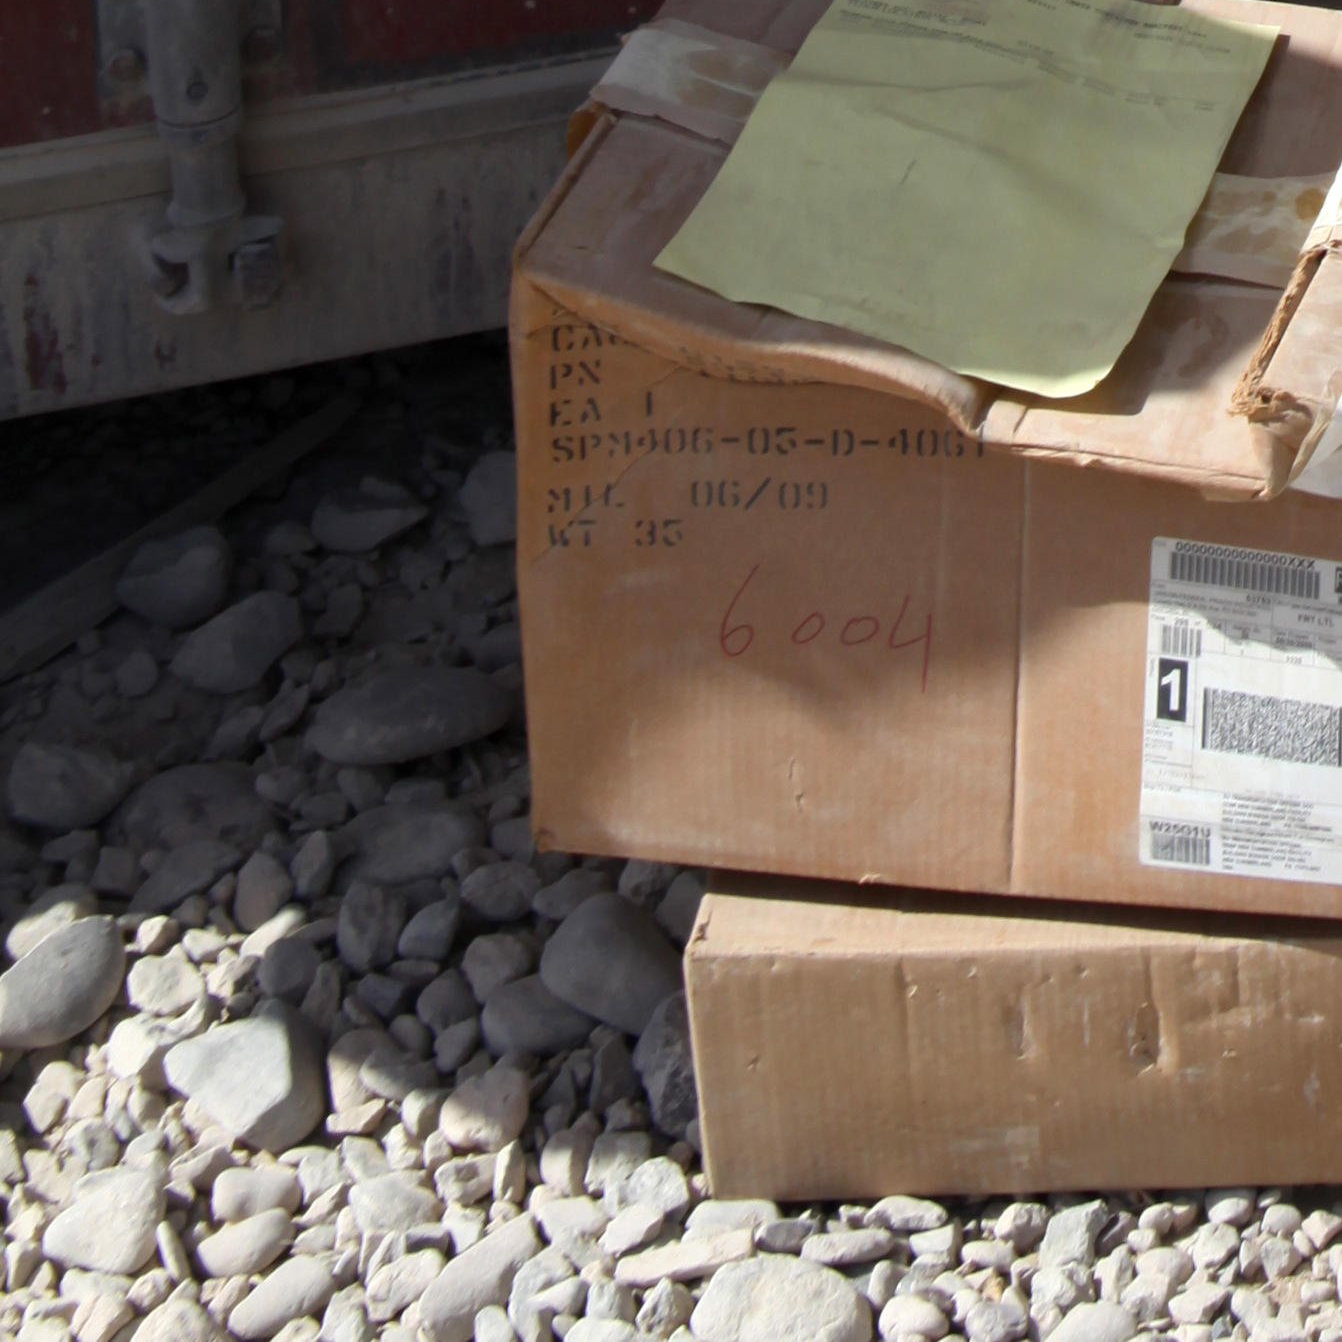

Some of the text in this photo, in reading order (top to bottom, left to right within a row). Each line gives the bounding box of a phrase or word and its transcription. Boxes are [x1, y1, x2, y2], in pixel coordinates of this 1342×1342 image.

[550, 359, 602, 390] PN
[550, 397, 602, 427] EA
[691, 477, 828, 511] 06/09
[548, 519, 684, 548] WT 35
[1160, 668, 1181, 713] 1
